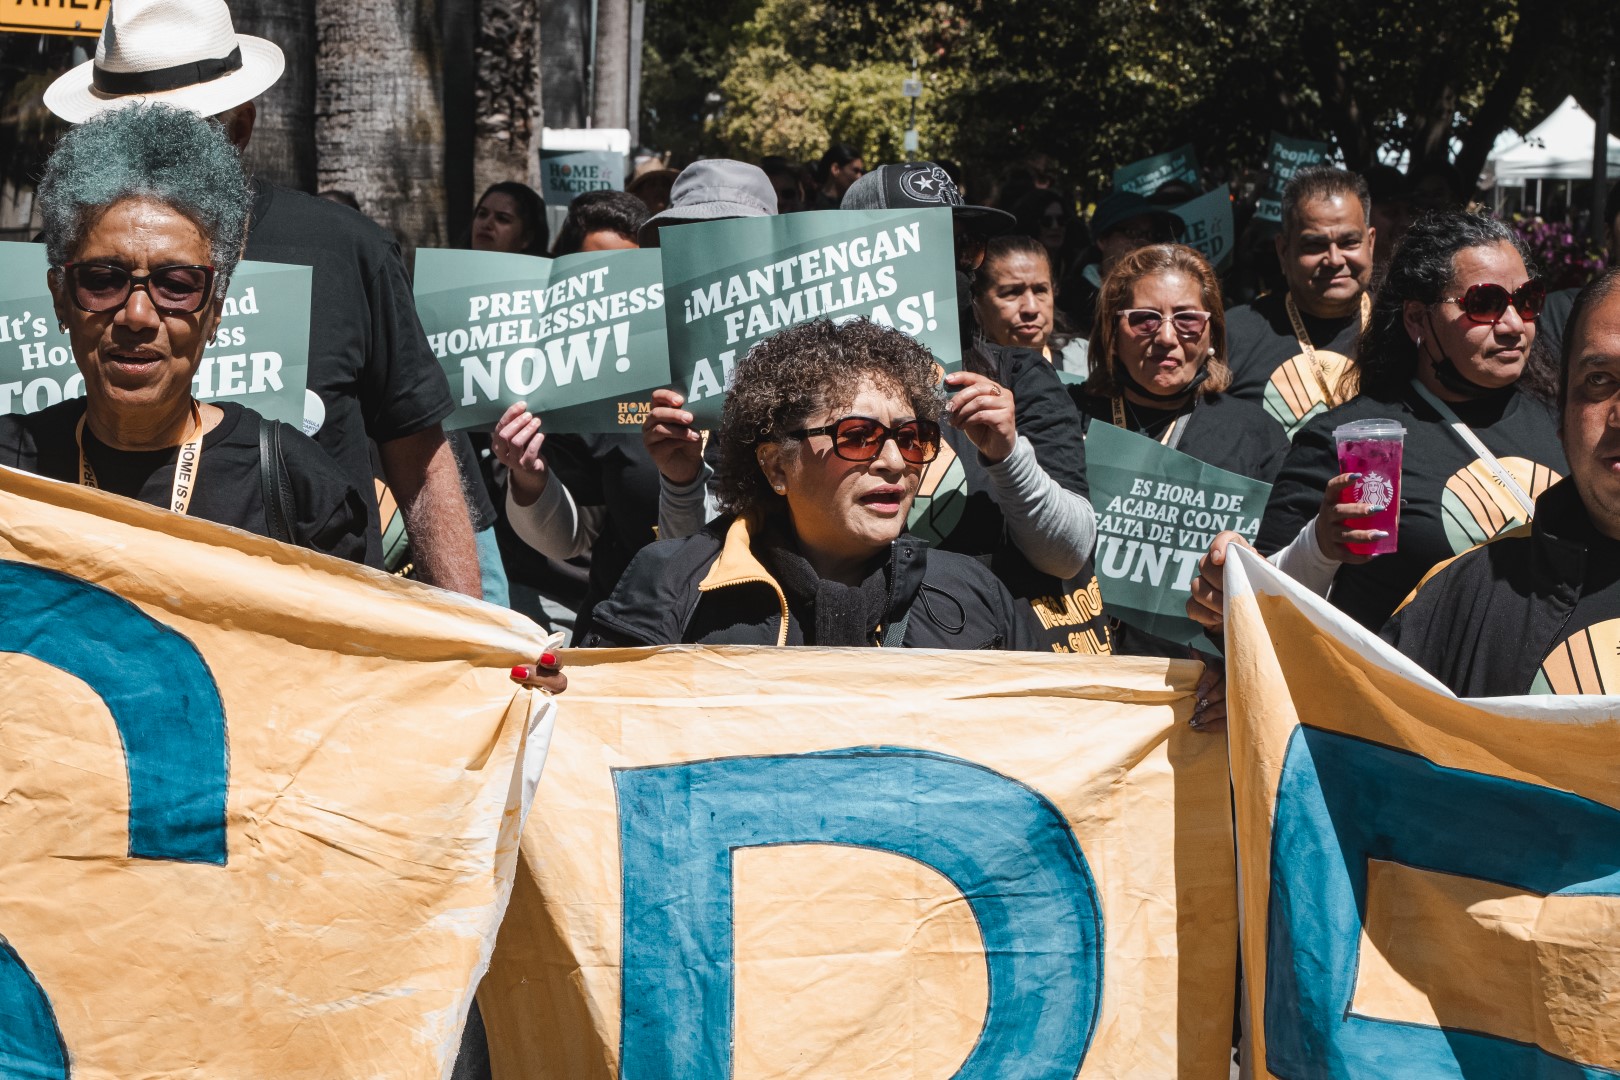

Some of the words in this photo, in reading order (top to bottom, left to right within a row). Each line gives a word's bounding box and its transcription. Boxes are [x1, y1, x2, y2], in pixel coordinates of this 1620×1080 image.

[549, 163, 599, 178] HOME
[1272, 142, 1320, 165] People
[549, 177, 612, 193] SACRED
[684, 221, 921, 324] ¡MANTENGAN
[221, 286, 260, 317] nd
[468, 266, 609, 322] PREVENT
[723, 265, 898, 345] FAMILIAS
[427, 283, 665, 359] HOMELESSNESS
[460, 321, 631, 407] NOW!
[617, 402, 651, 413] HOM
[178, 442, 197, 482] HOME
[176, 483, 189, 499] IS
[1130, 478, 1153, 497] ES
[1154, 482, 1206, 508] HORA
[1210, 493, 1244, 513] DE
[1106, 495, 1180, 524] ACABAR
[1183, 509, 1230, 531] CON
[1229, 516, 1260, 535] LA
[1148, 523, 1174, 543] DE
